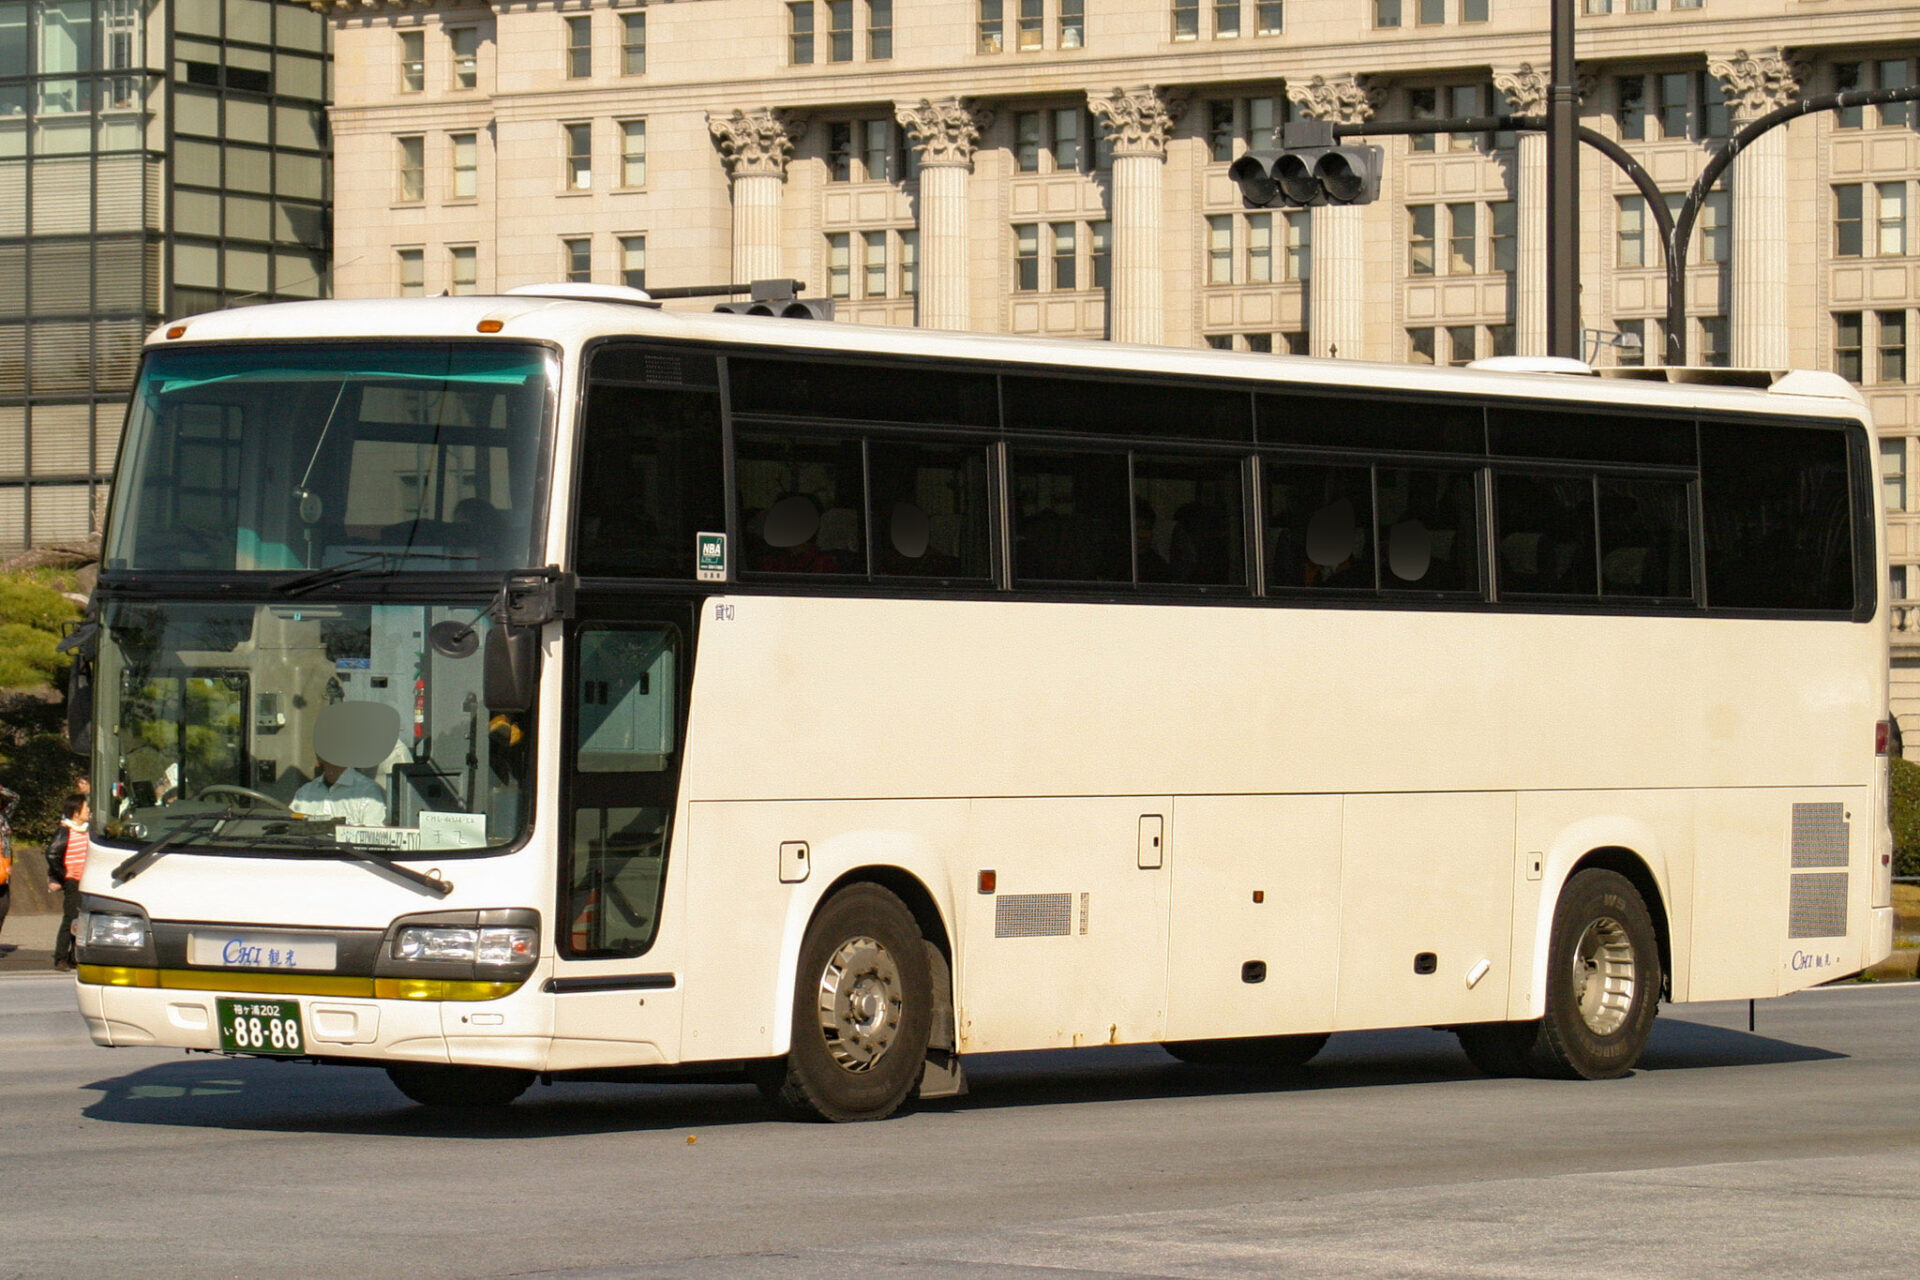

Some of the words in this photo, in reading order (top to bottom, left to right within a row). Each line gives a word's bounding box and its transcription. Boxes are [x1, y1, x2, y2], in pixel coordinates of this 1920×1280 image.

[702, 543, 721, 555] NBA
[715, 604, 735, 621] 貸切
[222, 937, 262, 964] CHI
[234, 1016, 299, 1049] 88-88
